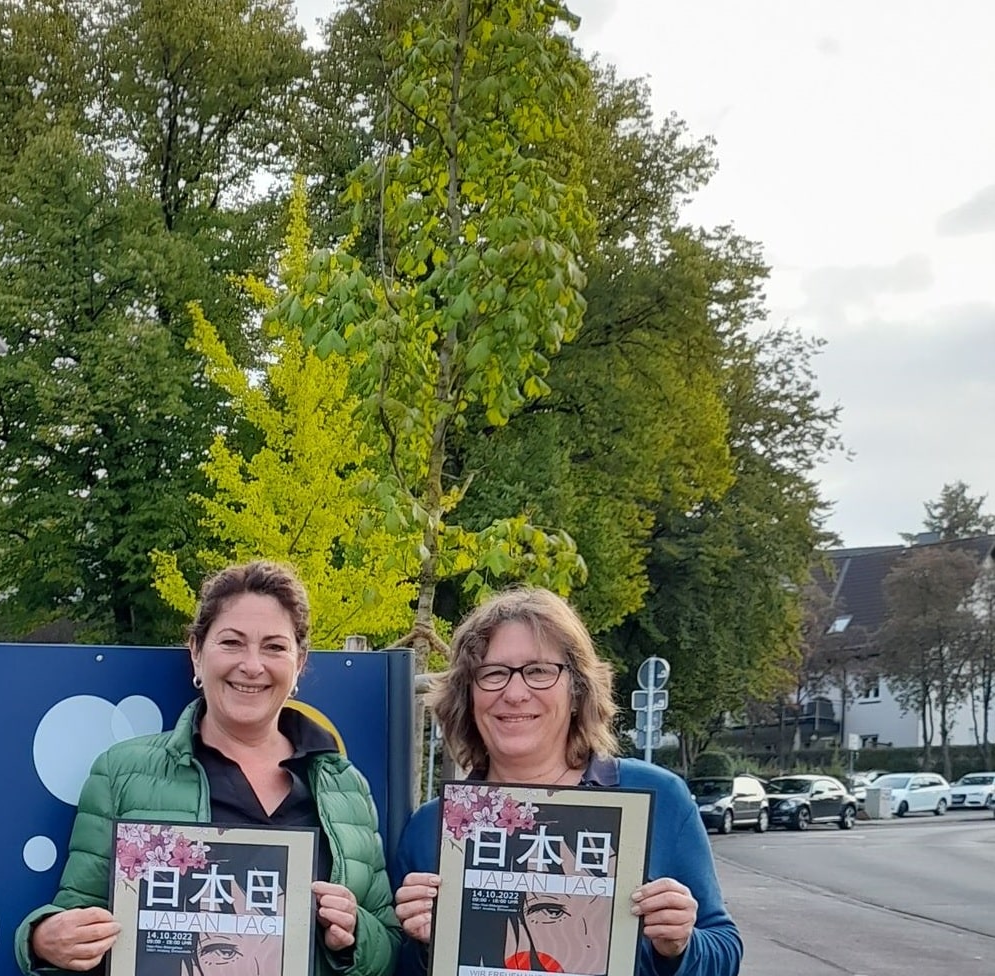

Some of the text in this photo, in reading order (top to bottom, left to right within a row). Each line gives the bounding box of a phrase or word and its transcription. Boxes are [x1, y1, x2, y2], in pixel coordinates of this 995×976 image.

[473, 825, 611, 873] 日本日
[146, 864, 279, 911] 日本日
[471, 871, 607, 896] JAPAN TAG
[472, 890, 519, 900] 14.10.2022
[146, 912, 277, 934] JAPAN TAG
[469, 969, 486, 976] WIR
